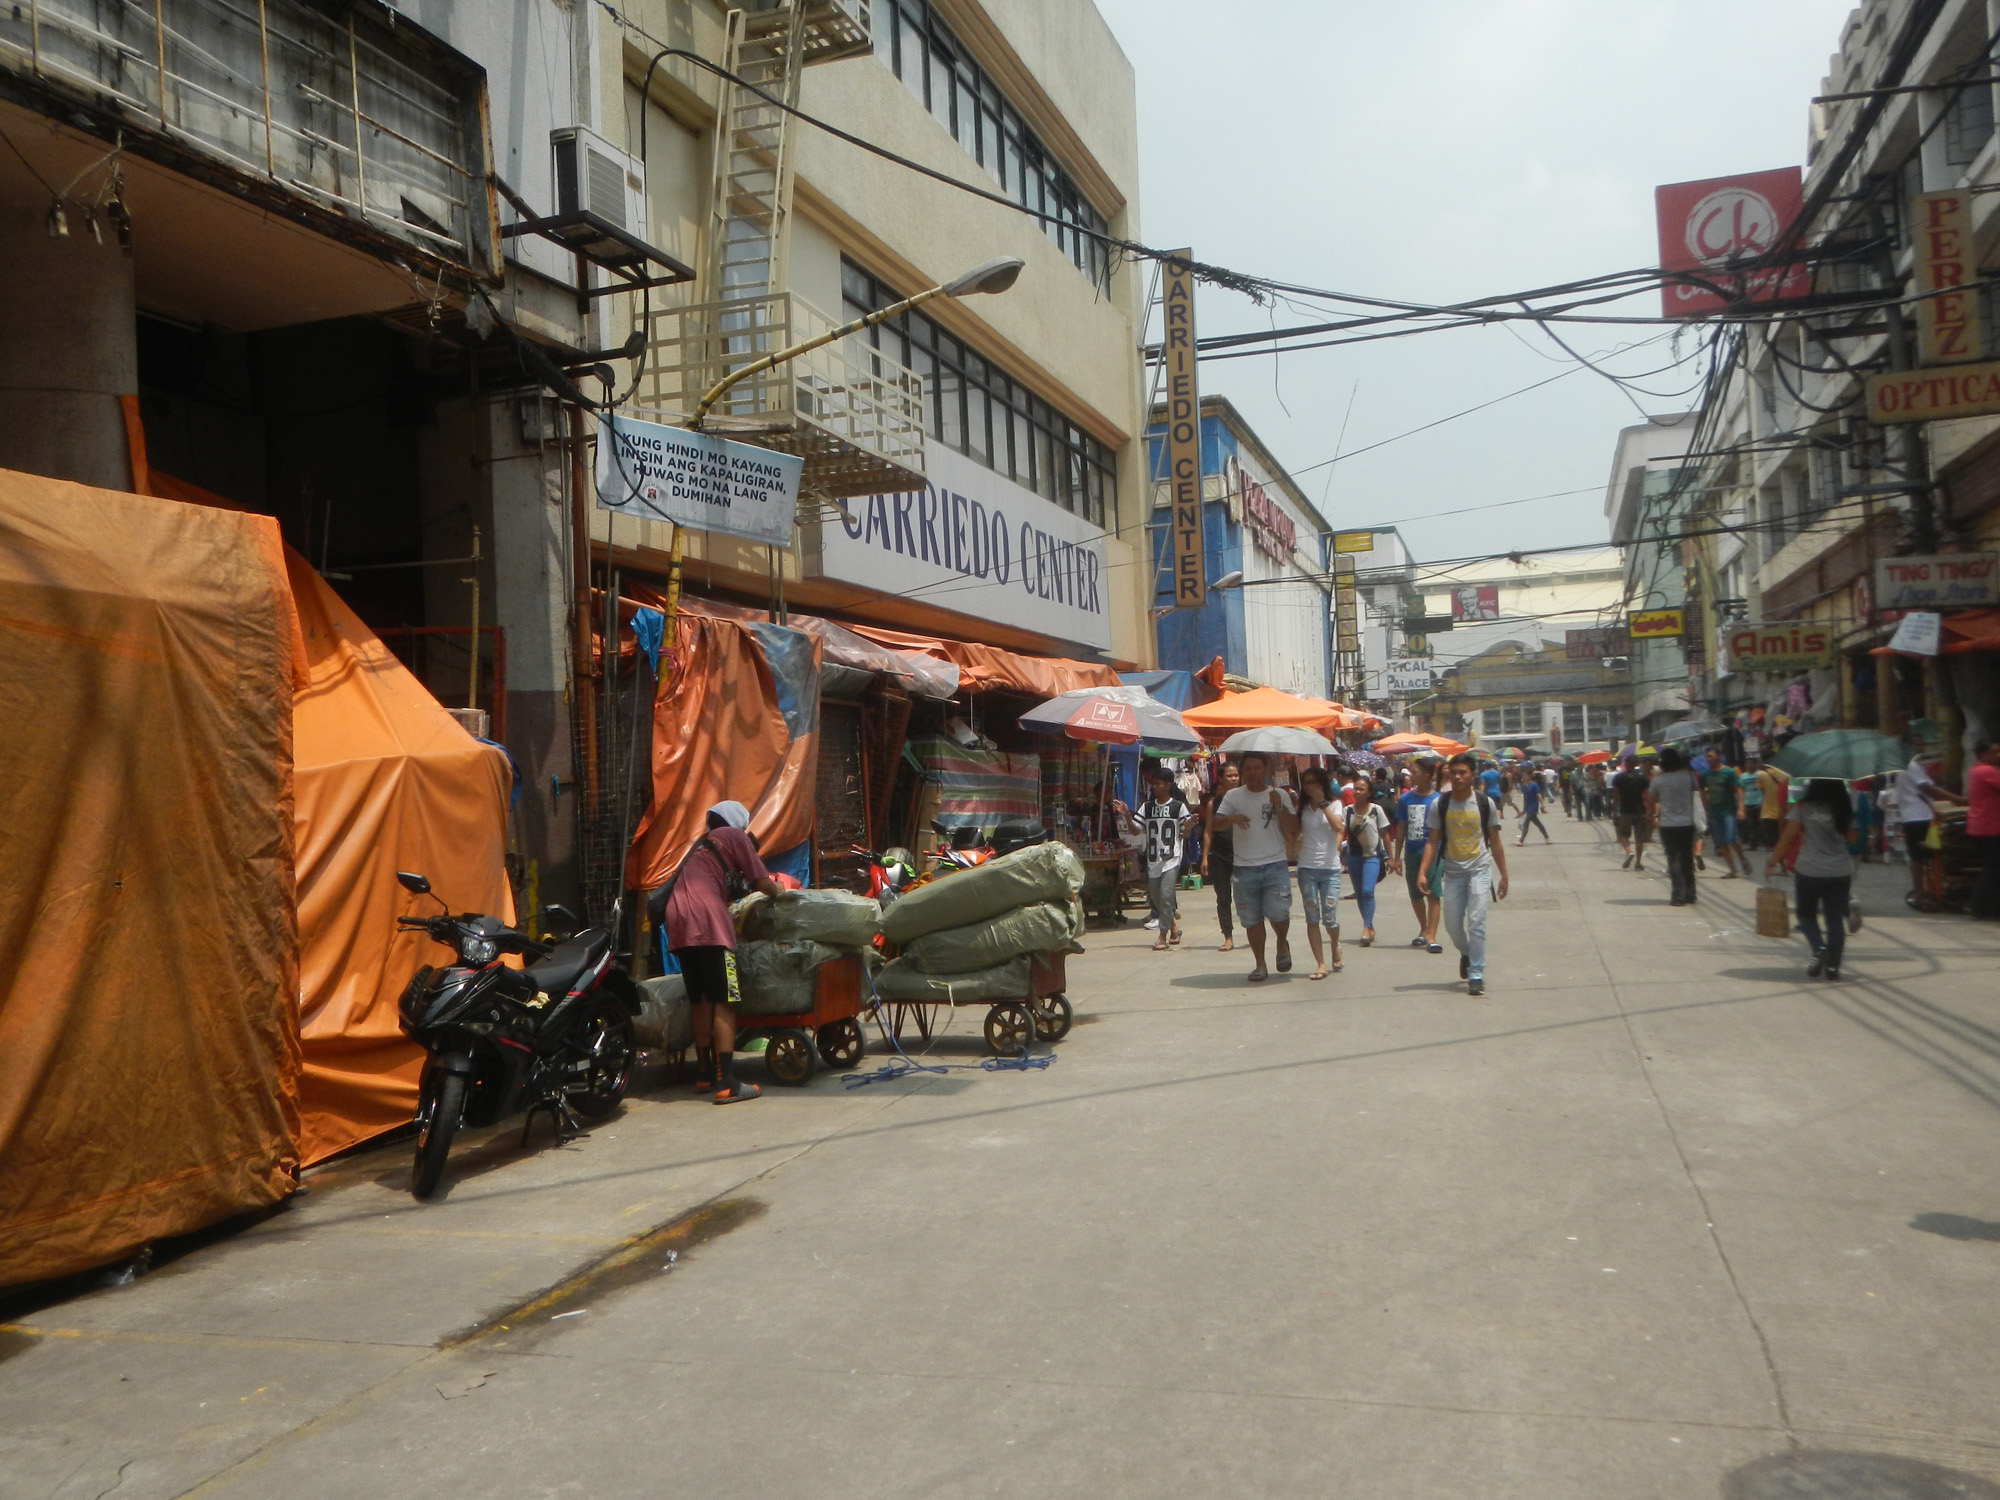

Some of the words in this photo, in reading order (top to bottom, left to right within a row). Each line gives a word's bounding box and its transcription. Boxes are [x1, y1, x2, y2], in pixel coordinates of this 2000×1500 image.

[1926, 197, 1968, 356] PEREZ
[612, 446, 663, 465] INISIN
[668, 457, 696, 472] ANG
[700, 464, 786, 495] KAPALIGIRAN,
[622, 433, 661, 450] KUNG
[667, 443, 703, 461] HINDI
[708, 452, 727, 465] MO
[732, 458, 781, 478] KAYANG
[634, 463, 684, 483] HUWAG
[689, 475, 708, 489] MO
[713, 480, 730, 494] NA
[734, 486, 767, 502] LANG
[672, 485, 731, 508] DUMIHAN
[839, 480, 1010, 585] CARRIEDO
[1020, 521, 1101, 614] CENTER
[1175, 457, 1200, 600] CENTER
[1731, 629, 1827, 658] Amis
[1386, 674, 1430, 689] PALACE
[1151, 806, 1170, 817] LEVEL
[1148, 820, 1176, 862] 69
